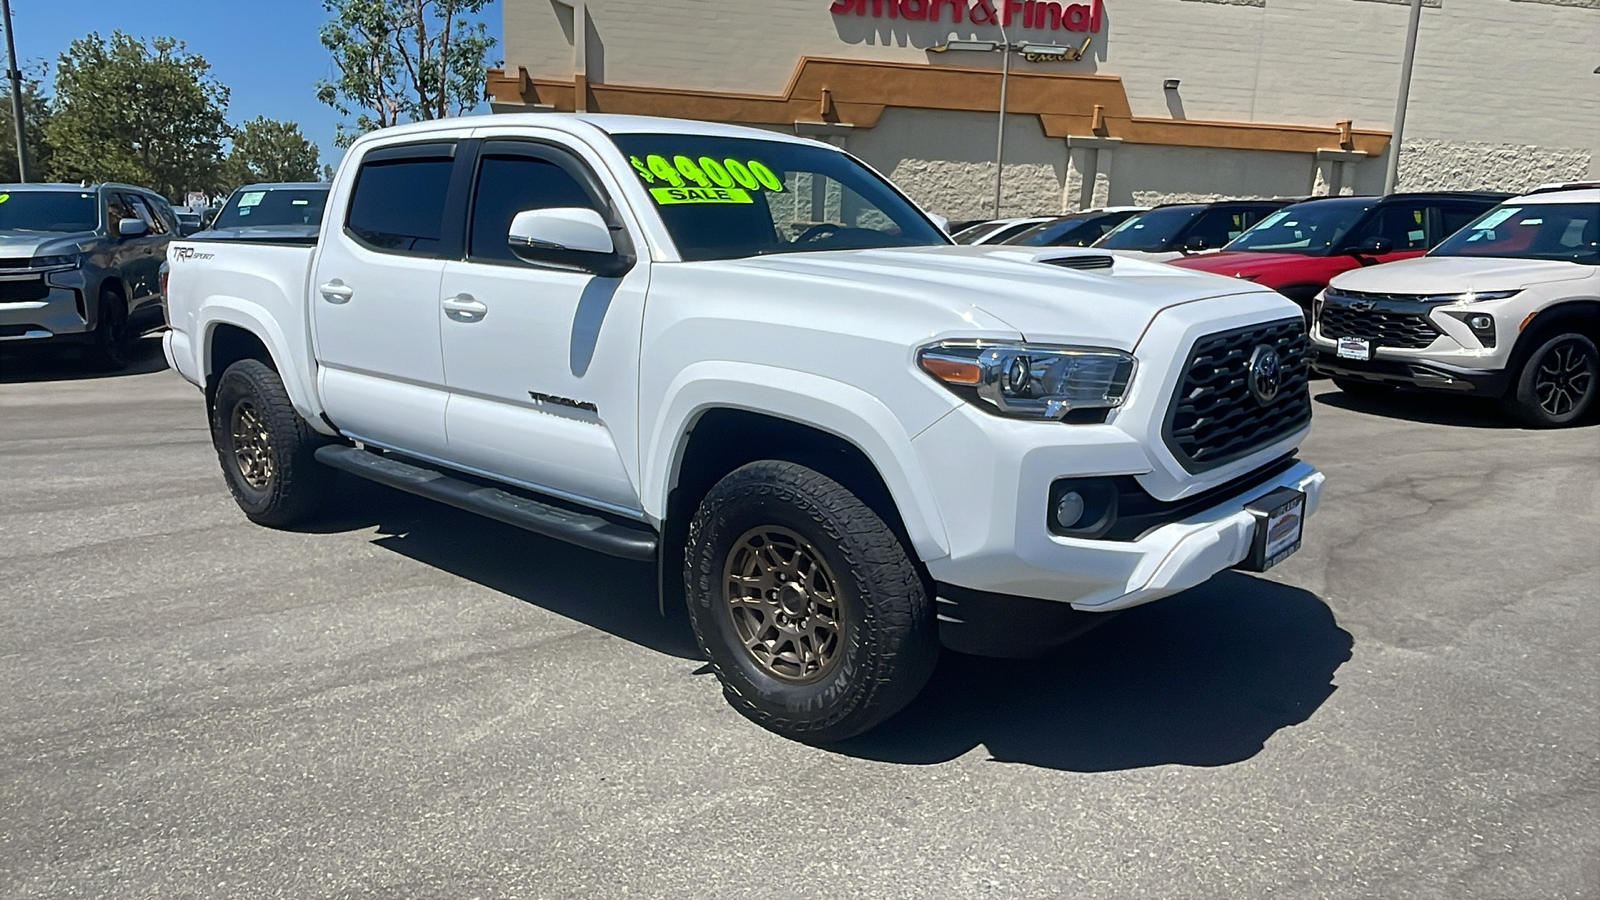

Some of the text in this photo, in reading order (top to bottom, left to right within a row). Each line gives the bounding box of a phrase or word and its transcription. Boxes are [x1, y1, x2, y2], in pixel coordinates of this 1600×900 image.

[667, 188, 731, 201] SALE
[173, 246, 216, 263] TRD SPORT
